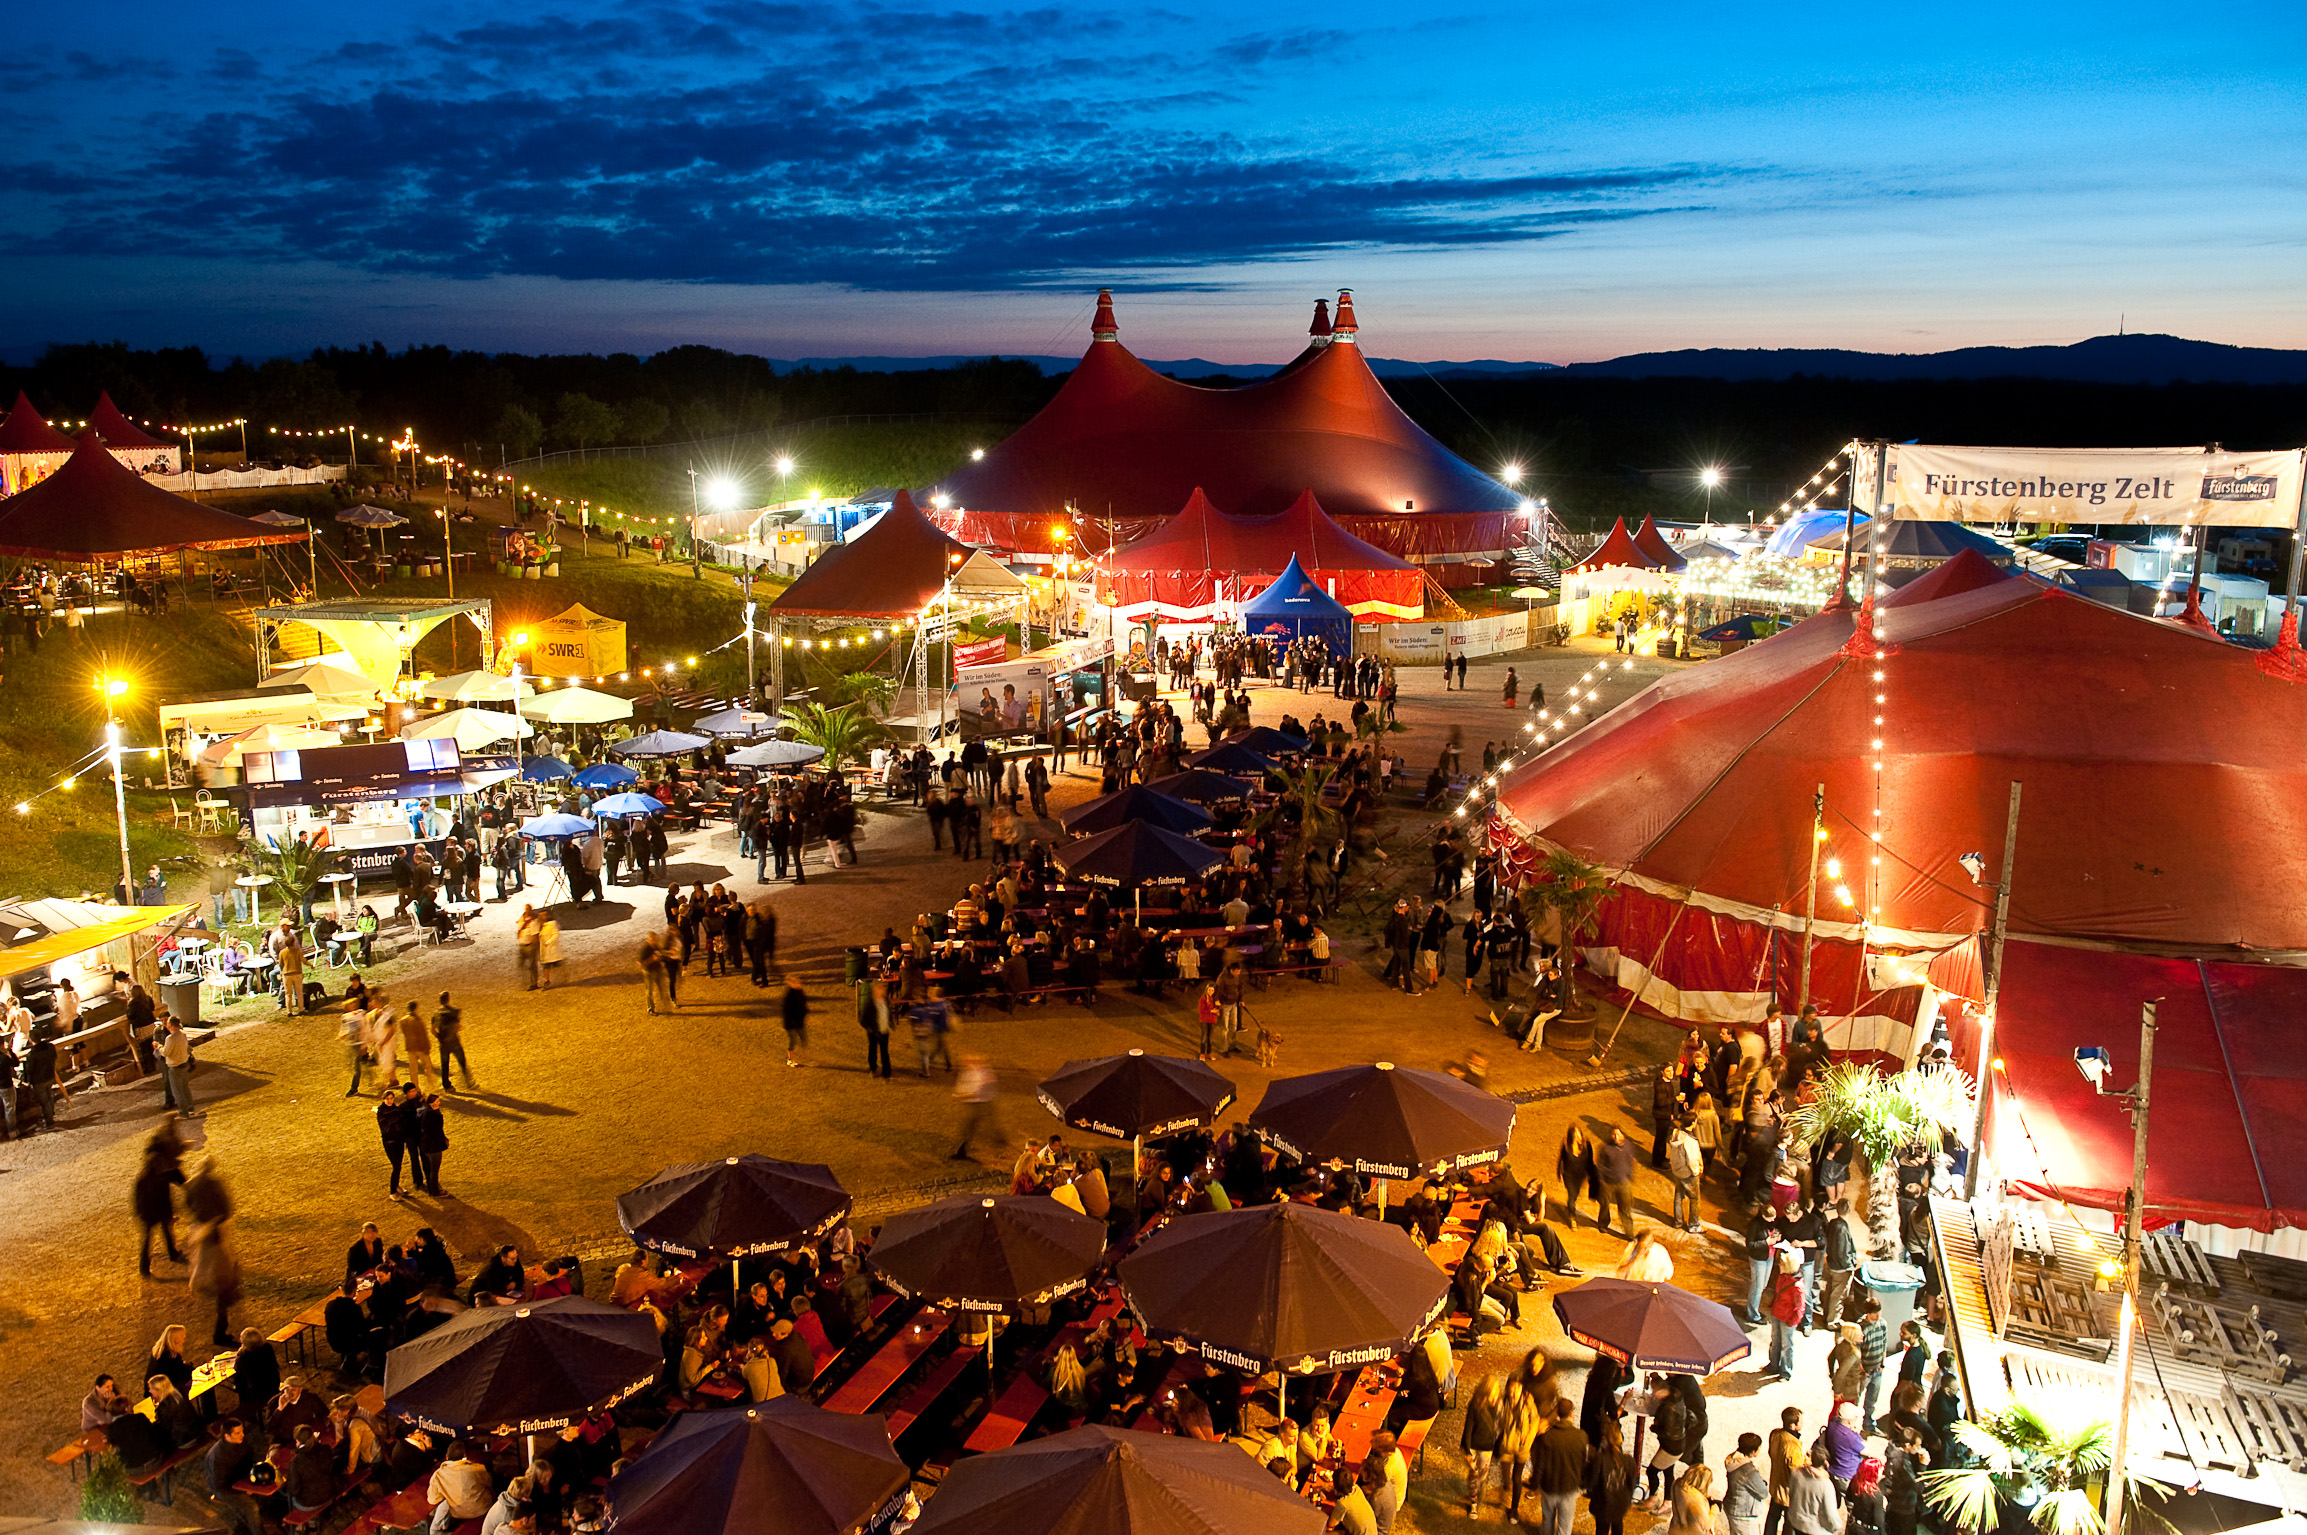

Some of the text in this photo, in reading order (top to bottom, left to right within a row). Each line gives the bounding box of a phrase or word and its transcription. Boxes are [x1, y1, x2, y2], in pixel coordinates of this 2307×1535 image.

[1925, 473, 2175, 505] Fürstenberg Zelt
[2208, 479, 2271, 497] Fürstenberg
[1451, 636, 1466, 645] ZMF
[548, 642, 585, 659] SWR1
[321, 787, 398, 799] Fürstenberg
[351, 852, 398, 869] stenber
[1092, 1120, 1125, 1139] Fürstenberg
[1167, 1116, 1199, 1132] Fürstenberg
[1355, 1158, 1409, 1179] Fürstenberg
[1455, 1148, 1499, 1171] Fürstenberg
[661, 1240, 697, 1259] Fürstenberg
[750, 1239, 790, 1256] Fürstenberg
[1053, 1277, 1087, 1299] Fürstenberg
[961, 1297, 1003, 1312] Fürstenberg
[1200, 1341, 1261, 1375] Fürstenberg
[1328, 1345, 1392, 1369] Fürstenberg
[418, 1415, 457, 1438] Fürstenberg
[519, 1416, 569, 1434] Fürstenberg
